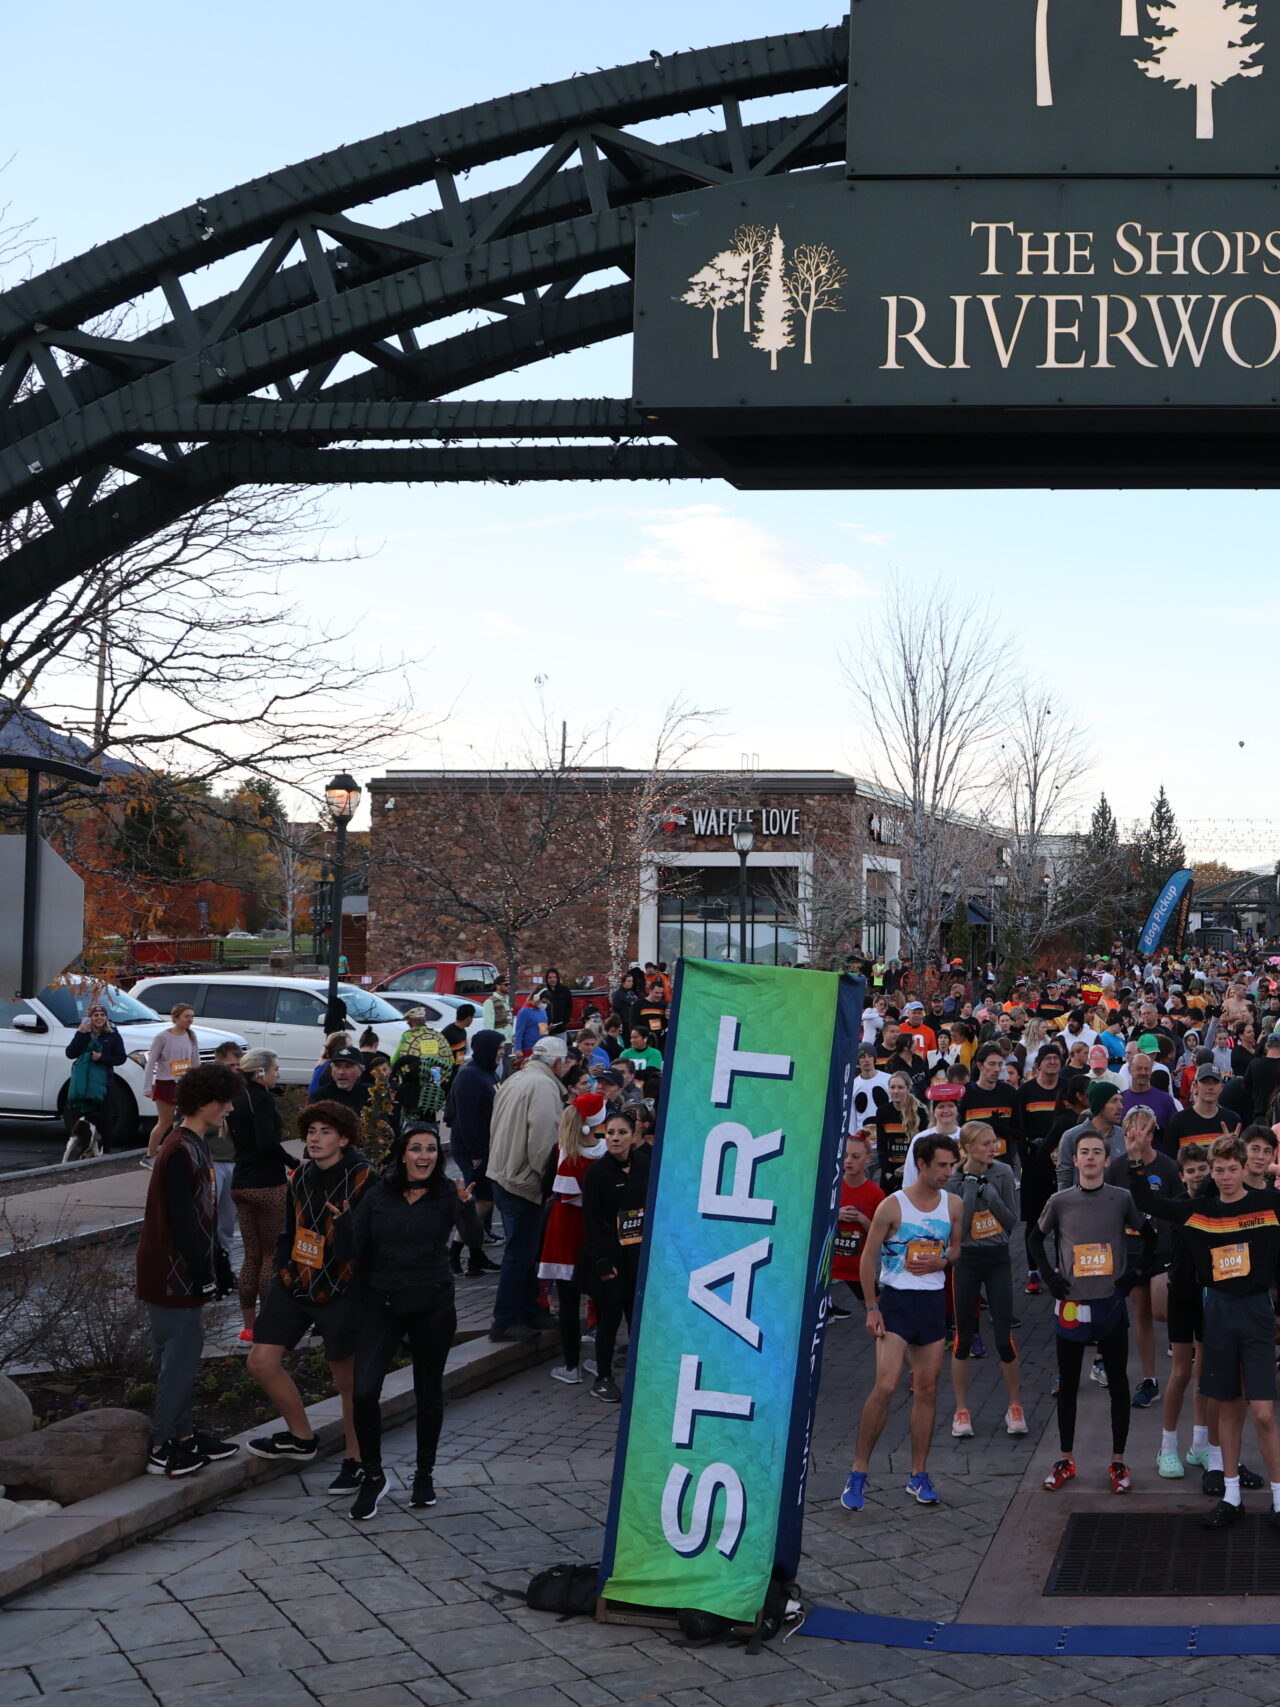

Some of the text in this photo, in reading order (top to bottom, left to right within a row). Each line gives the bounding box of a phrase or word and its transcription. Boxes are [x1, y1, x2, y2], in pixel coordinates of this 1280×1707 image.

[762, 808, 800, 835] LOVE
[1144, 885, 1177, 946] Bag Pickup
[830, 1063, 853, 1211] EVENTS
[297, 1239, 319, 1256] 2925
[834, 1237, 857, 1249] 6226
[1079, 1254, 1106, 1265] 2745
[1219, 1255, 1243, 1269] 3004
[661, 1014, 793, 1558] START
